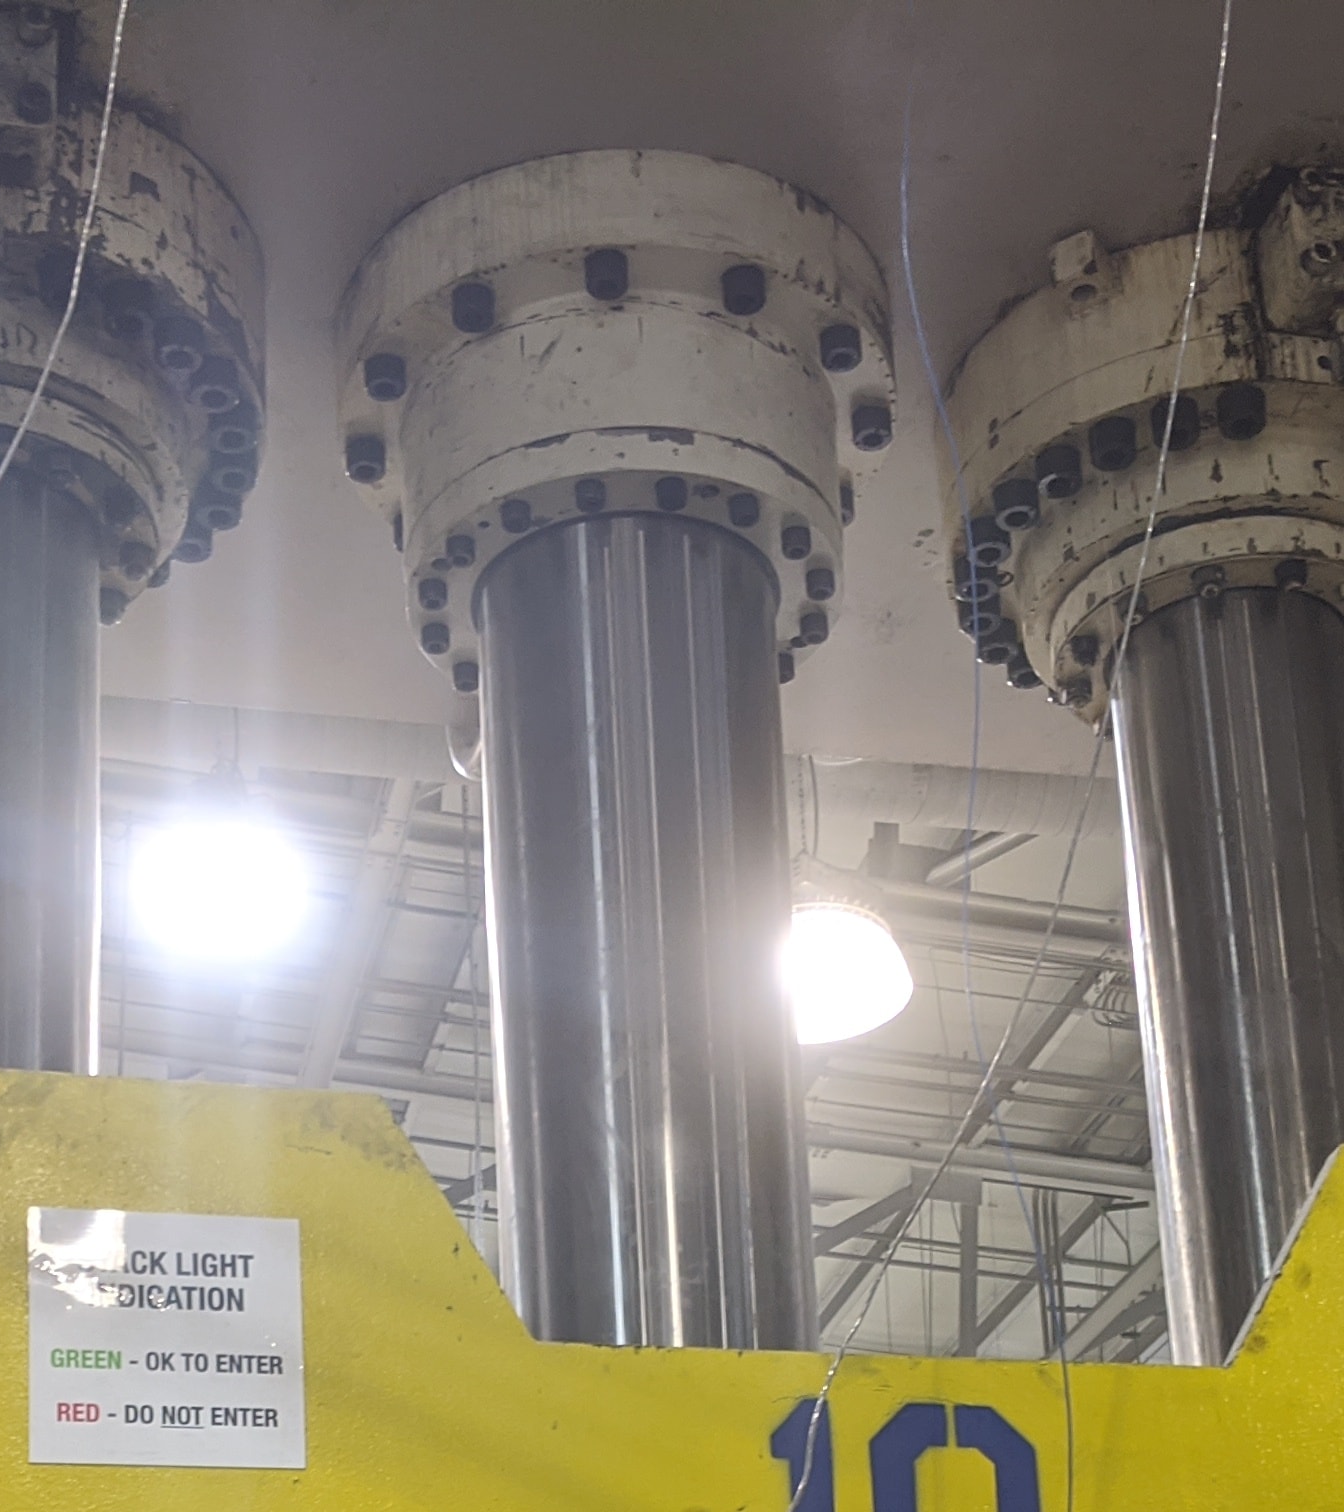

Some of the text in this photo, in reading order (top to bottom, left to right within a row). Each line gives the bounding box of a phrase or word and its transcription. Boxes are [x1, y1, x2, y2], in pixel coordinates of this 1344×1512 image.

[176, 1251, 255, 1278] LIGHT
[89, 1283, 244, 1312] DICATION
[50, 1348, 122, 1370] GREEN
[145, 1351, 175, 1372] OK
[181, 1352, 208, 1373] TO
[215, 1354, 283, 1375] ENTER
[56, 1402, 100, 1422] RED
[124, 1404, 154, 1424] DO
[161, 1405, 204, 1427] NOT
[211, 1407, 279, 1428] ENTER
